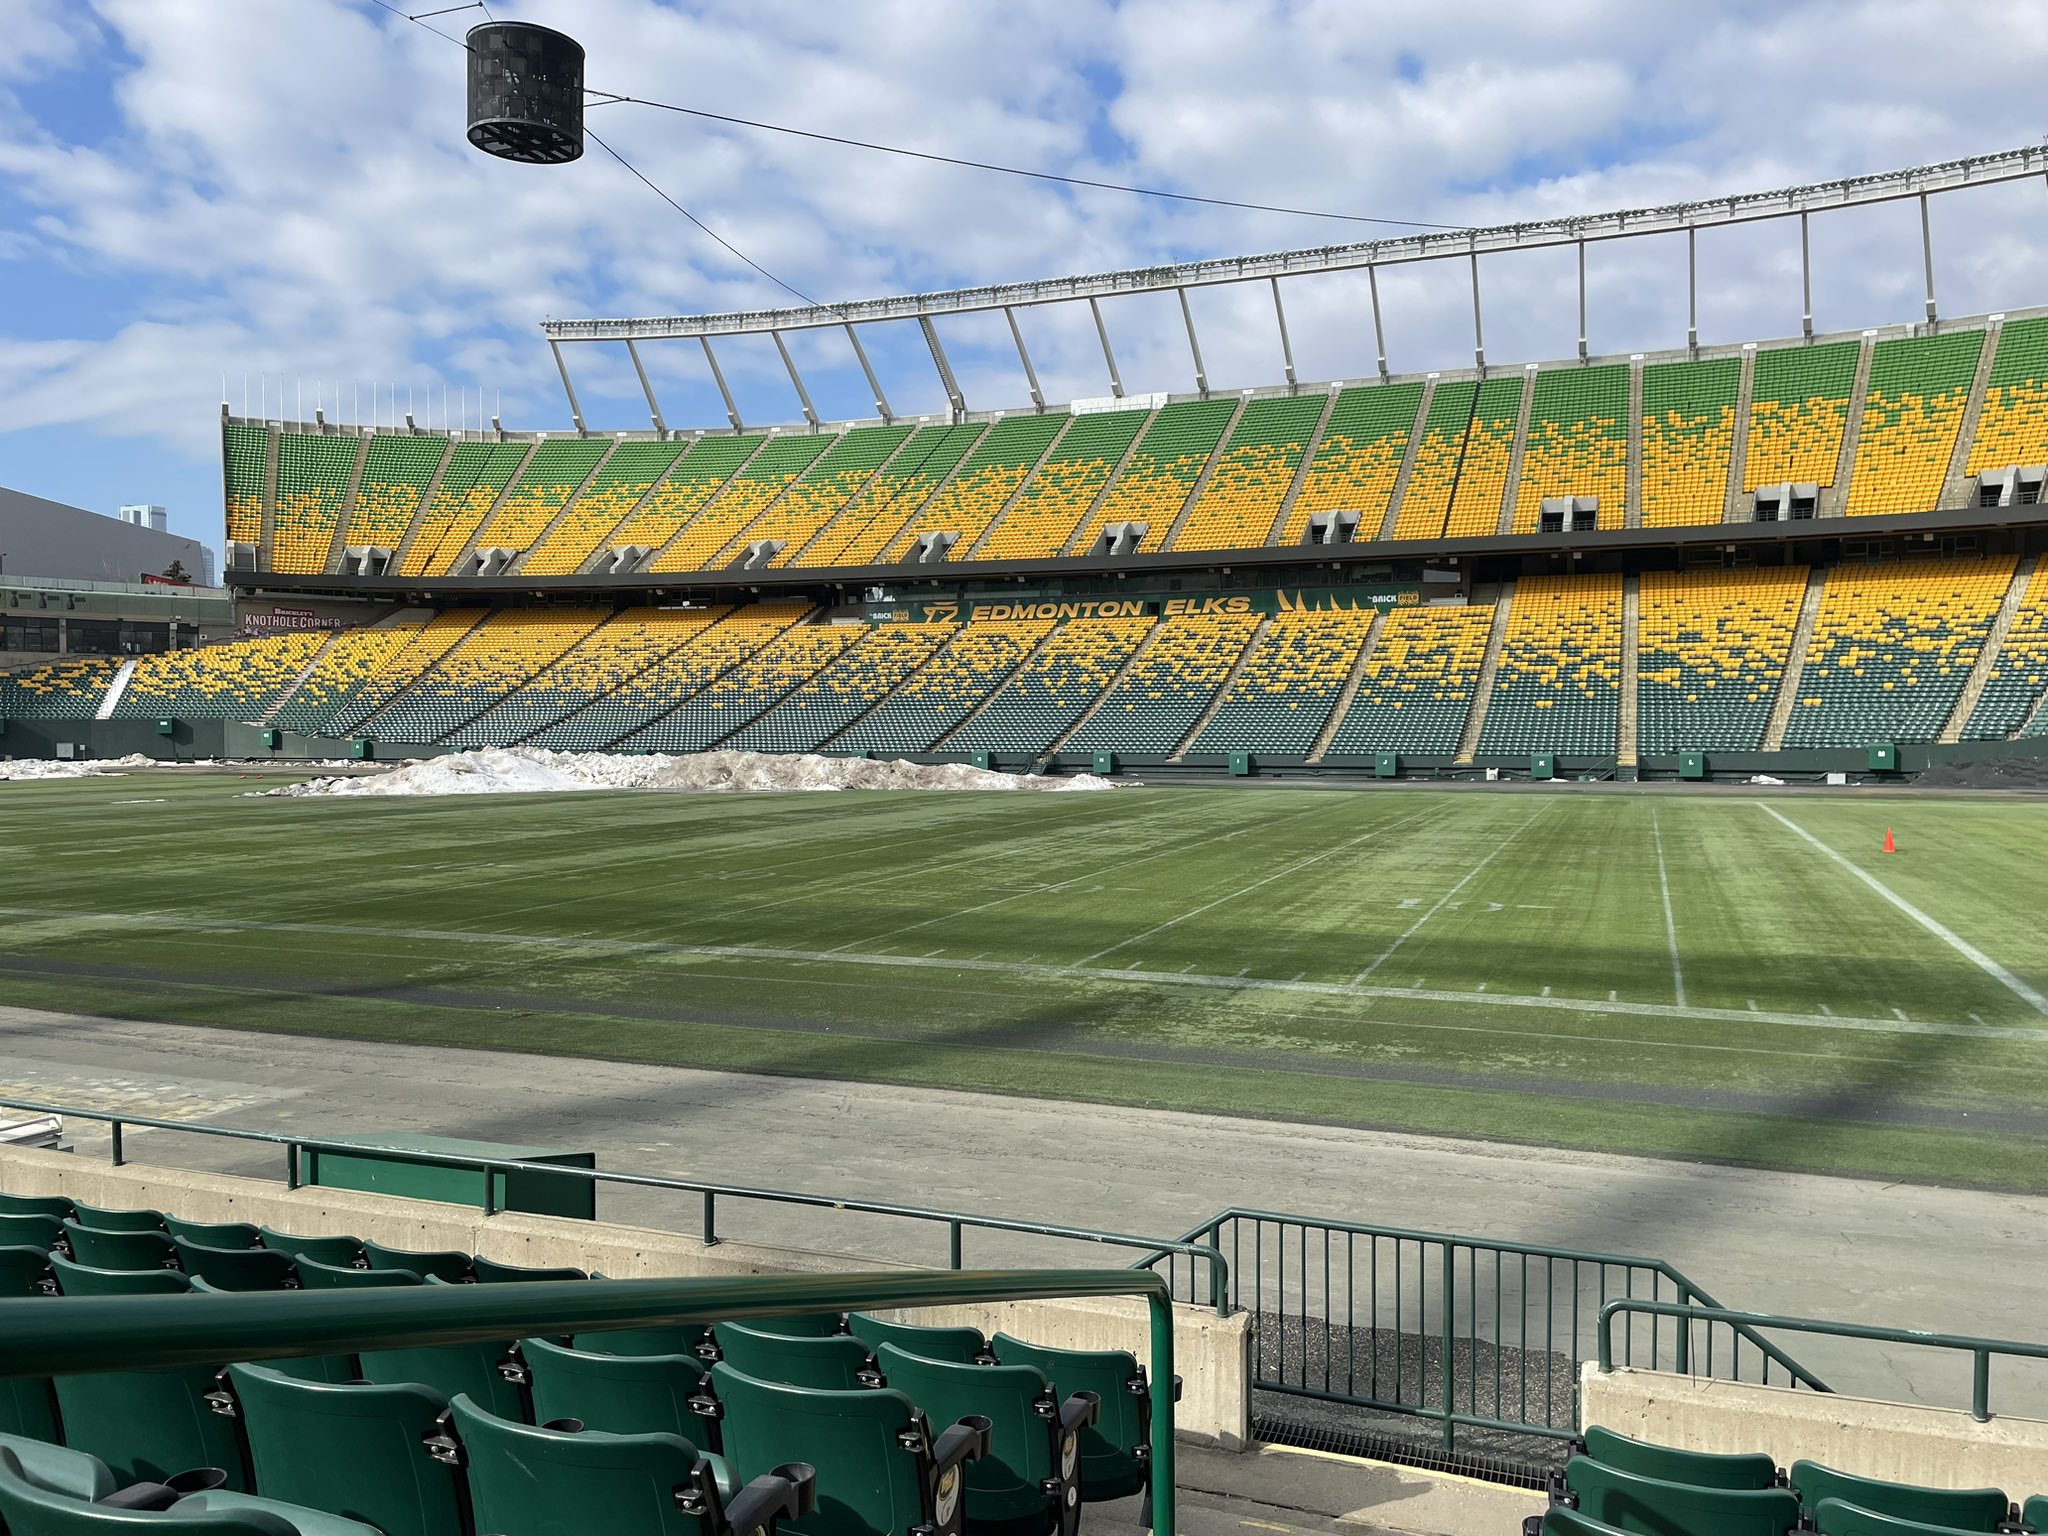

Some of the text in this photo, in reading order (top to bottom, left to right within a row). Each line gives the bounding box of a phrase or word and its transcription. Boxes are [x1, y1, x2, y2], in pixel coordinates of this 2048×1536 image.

[1372, 594, 1397, 603] BRICK
[971, 597, 1252, 621] EDMONTON ELKS
[245, 614, 299, 627] KNOTHOLE
